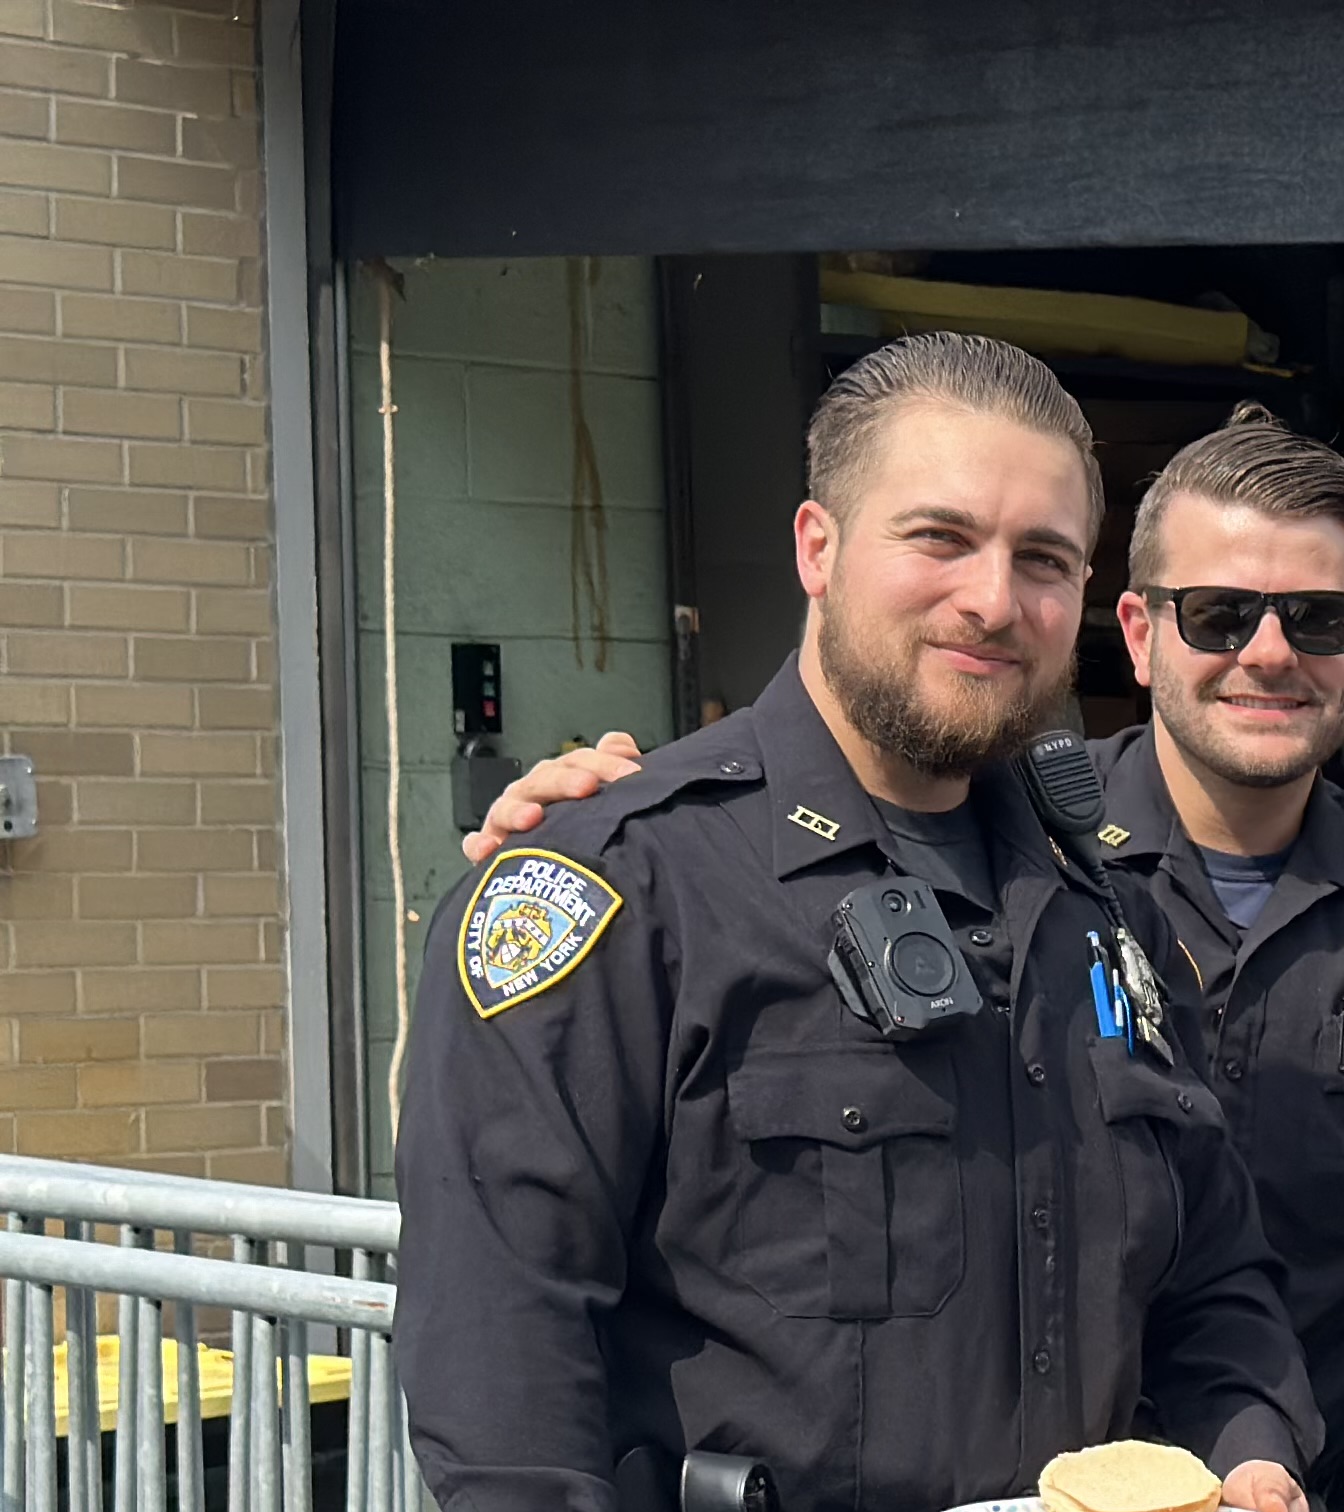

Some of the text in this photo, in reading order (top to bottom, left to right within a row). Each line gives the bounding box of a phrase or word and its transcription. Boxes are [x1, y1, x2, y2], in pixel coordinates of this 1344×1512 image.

[484, 875, 596, 928] DEPARTMENT
[519, 859, 588, 897] POLICE
[467, 911, 487, 979] CITY OF
[502, 931, 584, 997] NEW YORK
